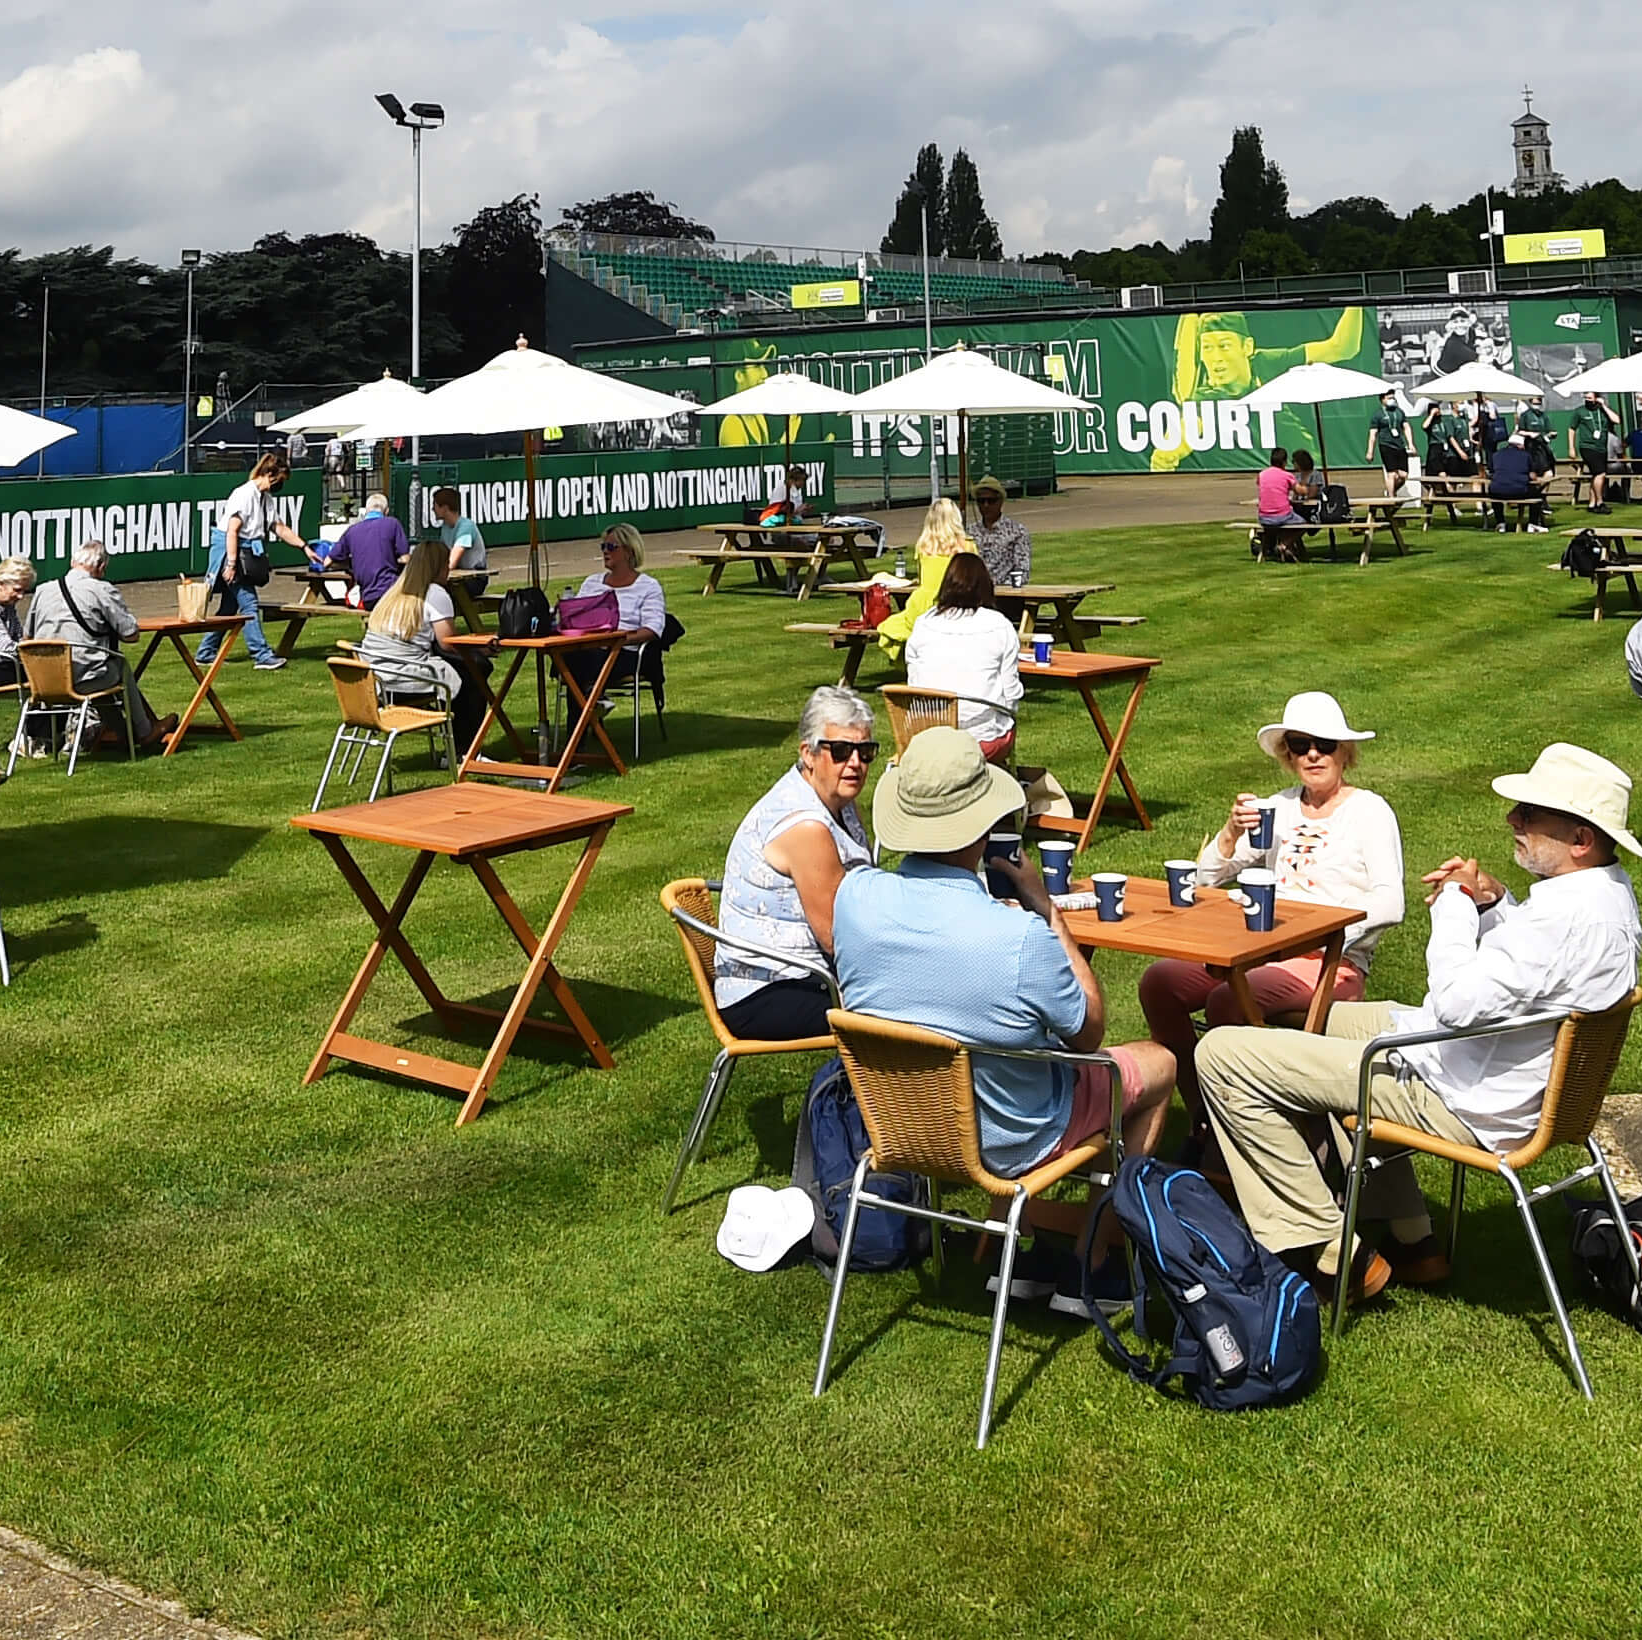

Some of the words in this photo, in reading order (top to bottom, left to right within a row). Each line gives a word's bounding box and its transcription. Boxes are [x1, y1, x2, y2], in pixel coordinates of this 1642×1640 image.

[1116, 399, 1283, 453] COURT
[557, 475, 607, 518] OPEN
[611, 472, 650, 513] AND
[653, 466, 761, 510] NOTTINGHAM
[764, 462, 825, 502] TRHY
